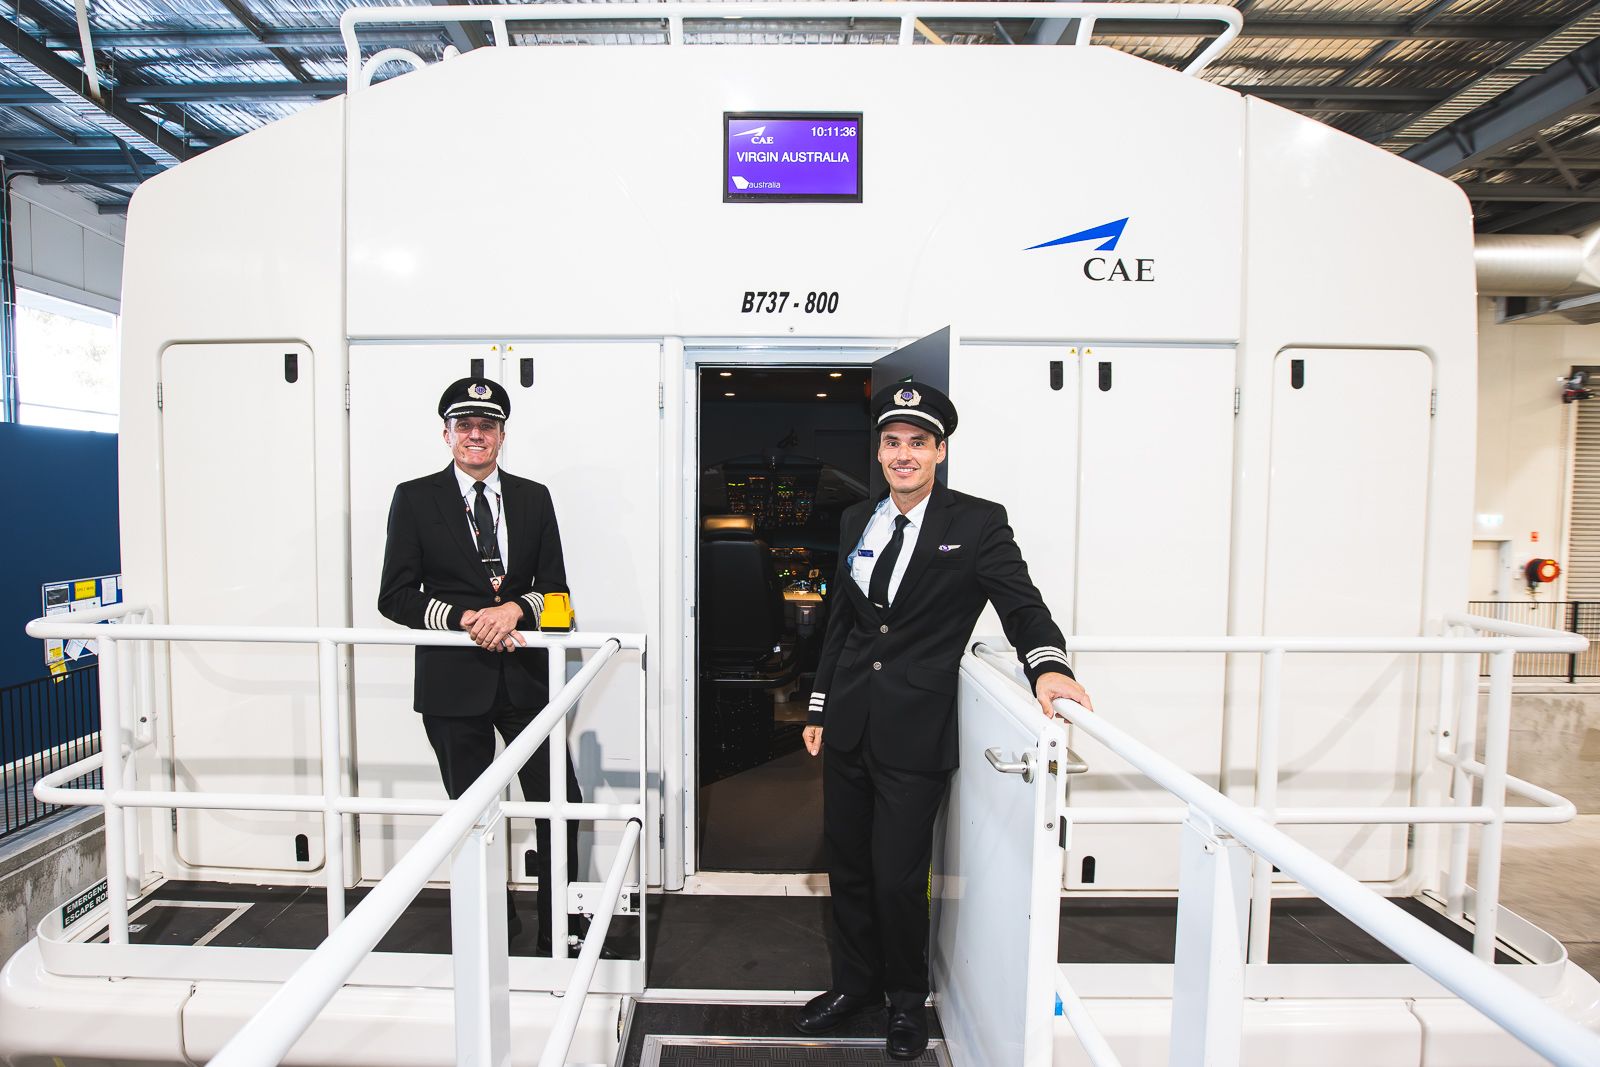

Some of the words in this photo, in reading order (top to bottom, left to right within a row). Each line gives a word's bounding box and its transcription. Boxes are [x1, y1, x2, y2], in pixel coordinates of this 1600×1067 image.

[811, 126, 857, 137] 10:11:36
[751, 136, 774, 145] CAE
[736, 151, 779, 163] VIRGIN
[781, 151, 850, 163] AUSTRALIA
[748, 181, 781, 189] australia
[1083, 257, 1155, 282] CAE
[741, 291, 790, 313] B737
[804, 291, 839, 314] 800
[67, 881, 107, 913] EMERGENC
[65, 900, 95, 926] ESCAPE
